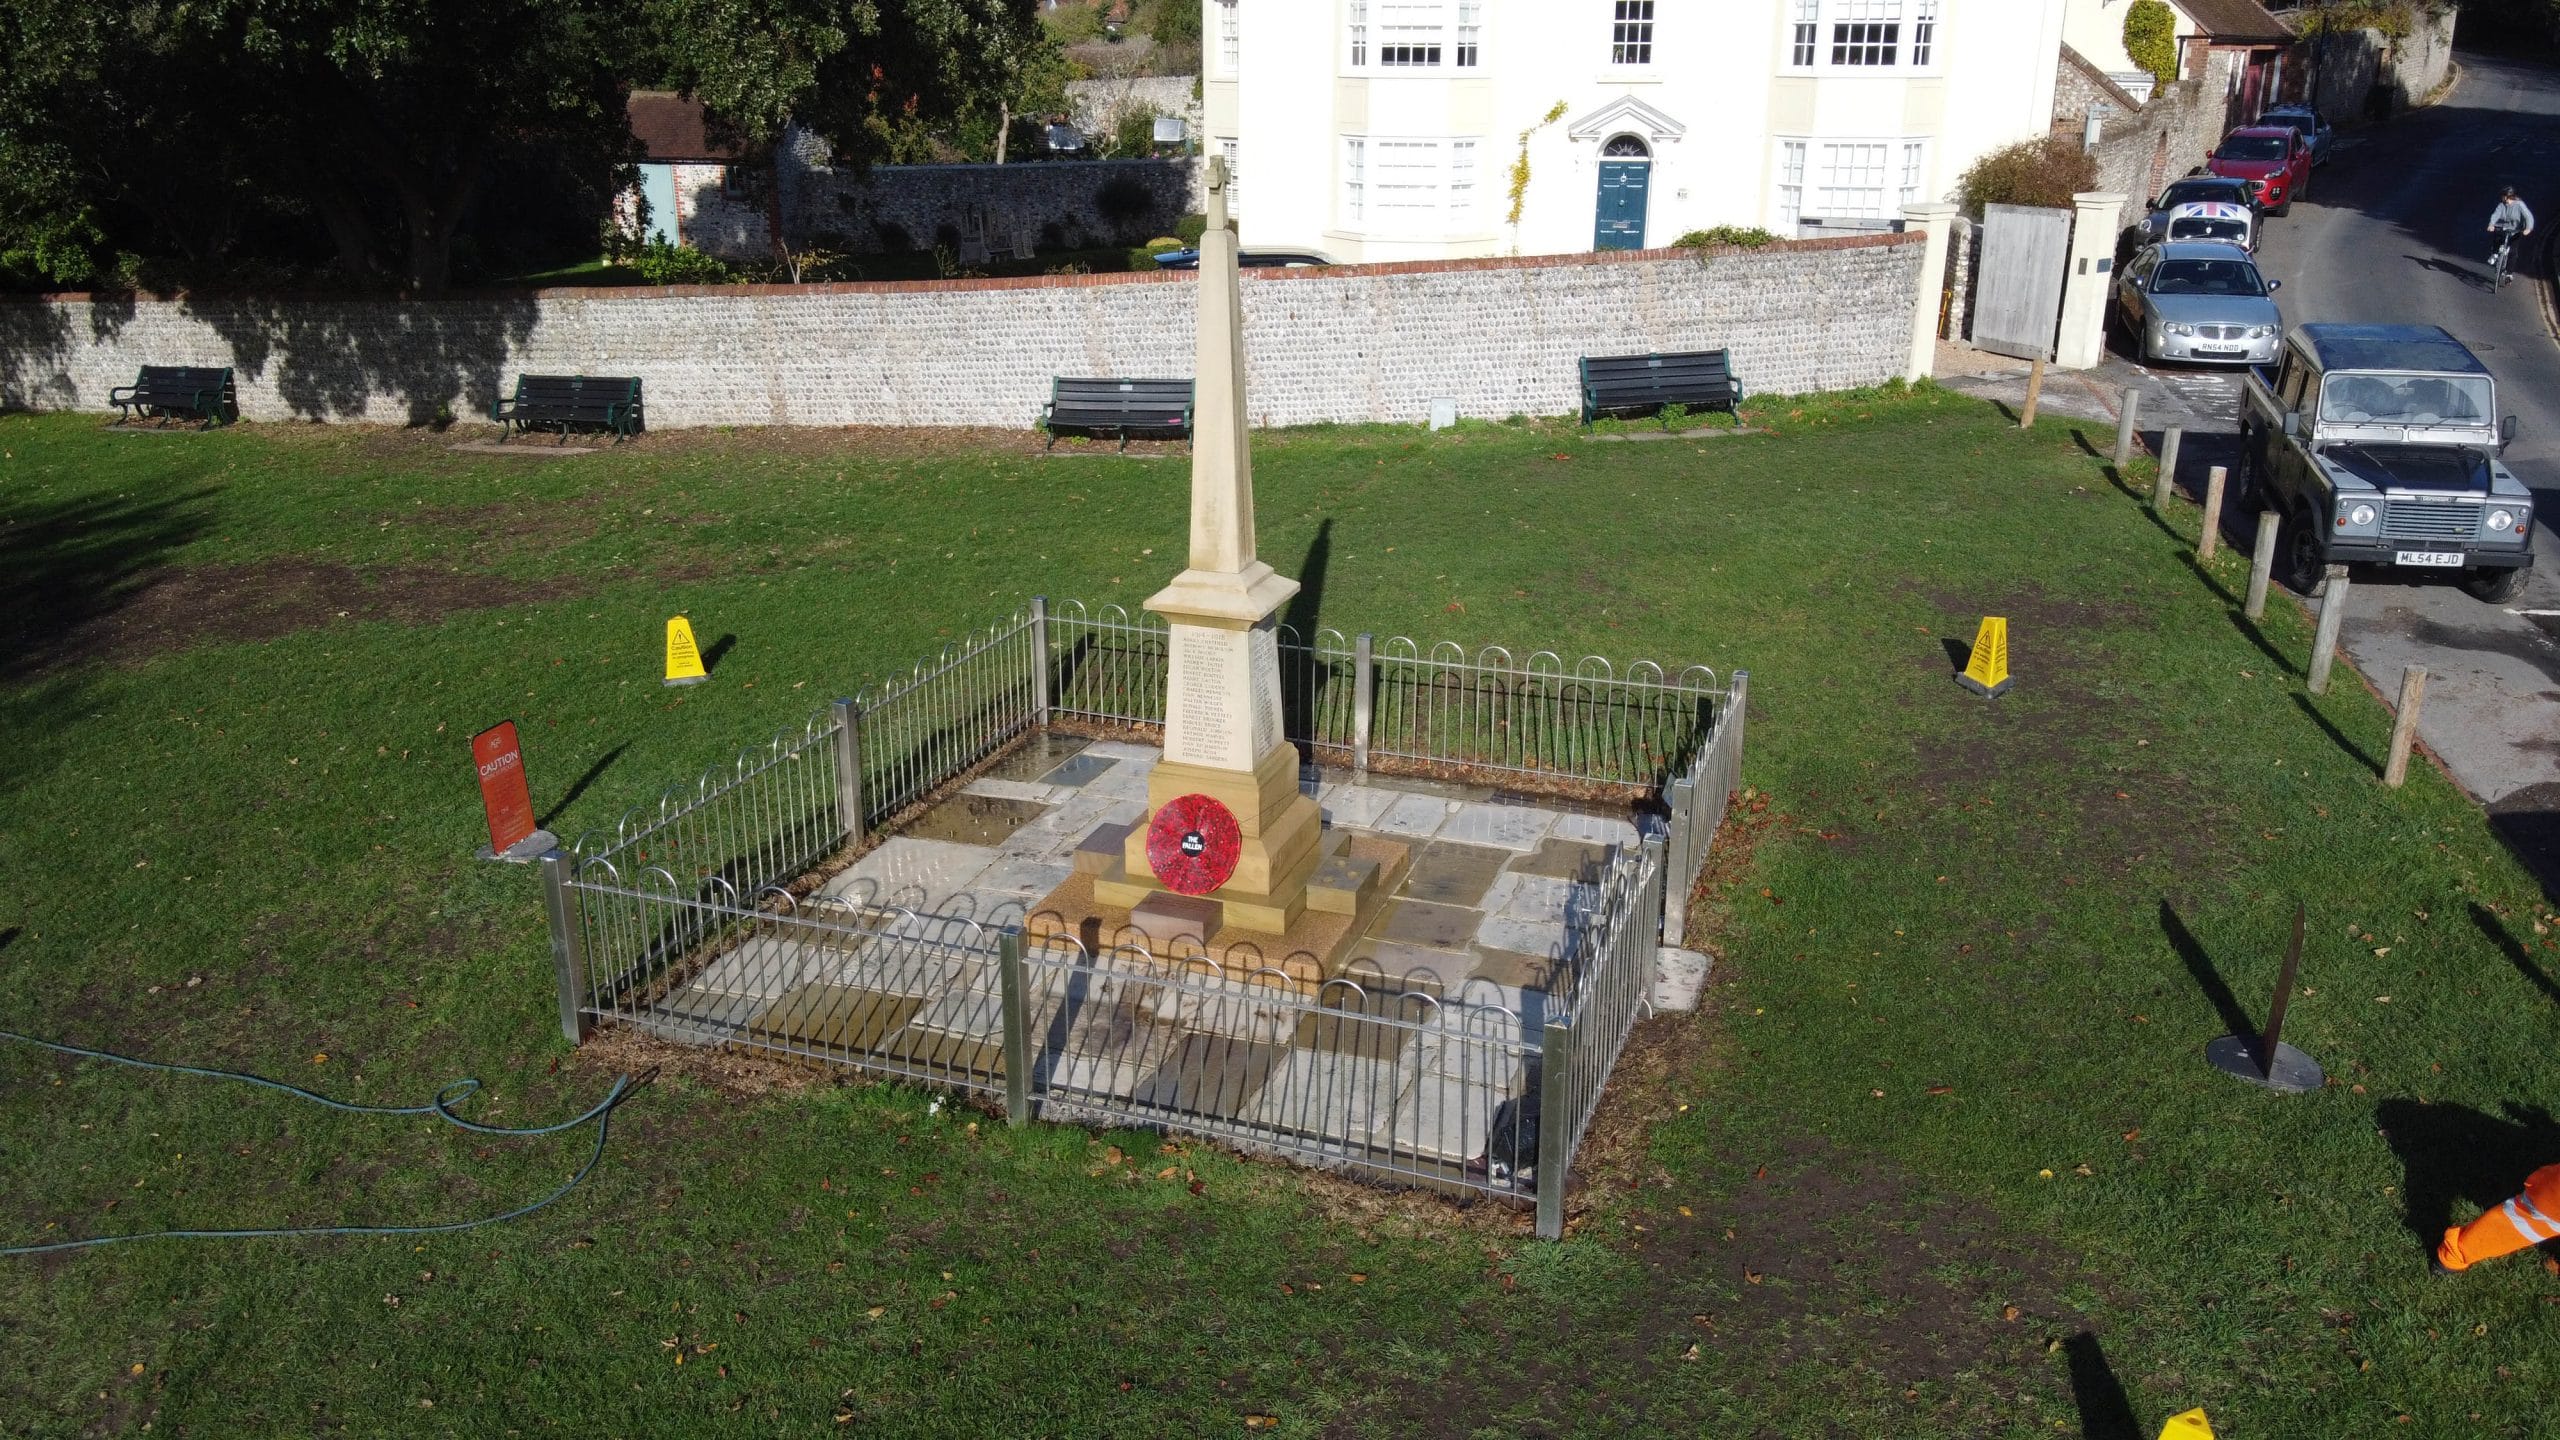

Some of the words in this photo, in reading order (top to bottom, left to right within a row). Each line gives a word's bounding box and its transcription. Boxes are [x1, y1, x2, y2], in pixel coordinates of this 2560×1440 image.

[2400, 552, 2432, 563] ML54
[2435, 554, 2459, 565] EJD
[480, 749, 518, 776] CAUTION
[1182, 842, 1203, 850] FALLEN
